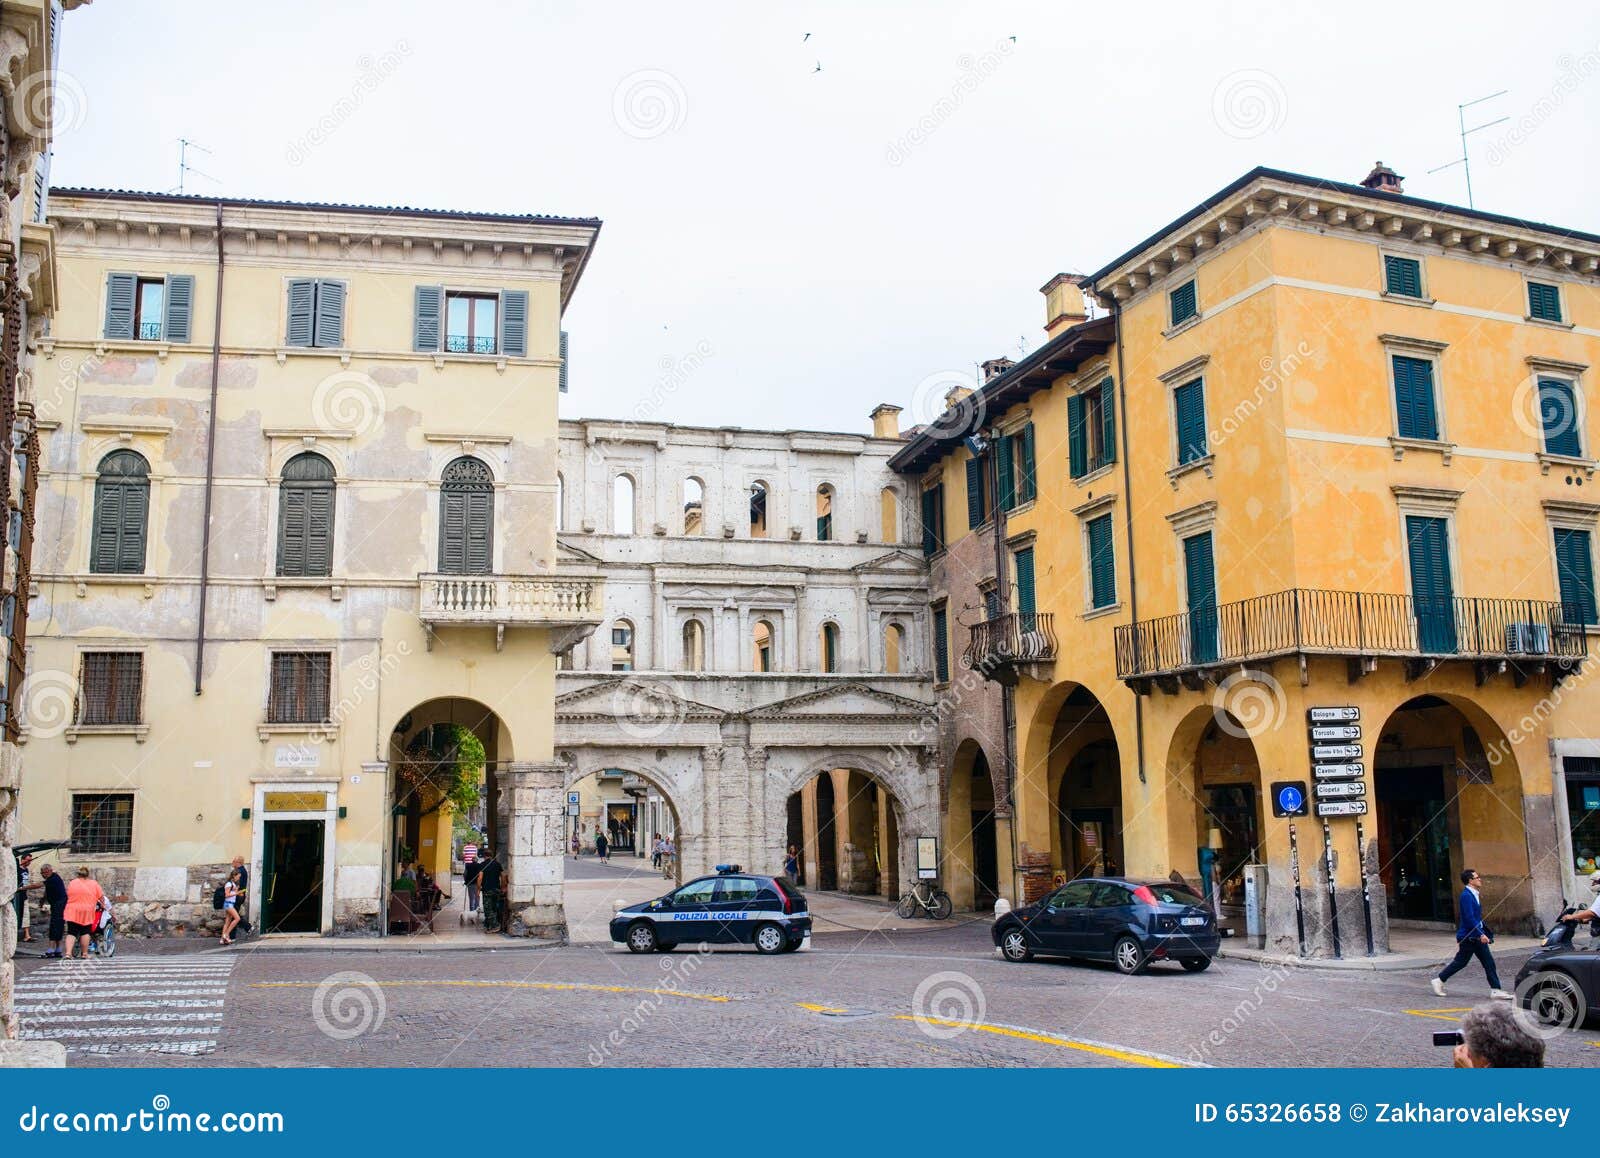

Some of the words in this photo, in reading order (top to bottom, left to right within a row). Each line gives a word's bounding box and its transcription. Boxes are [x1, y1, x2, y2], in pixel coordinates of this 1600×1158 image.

[1320, 805, 1340, 813] Europa
[673, 912, 709, 921] POLIZIA
[712, 912, 748, 920] LOCALE
